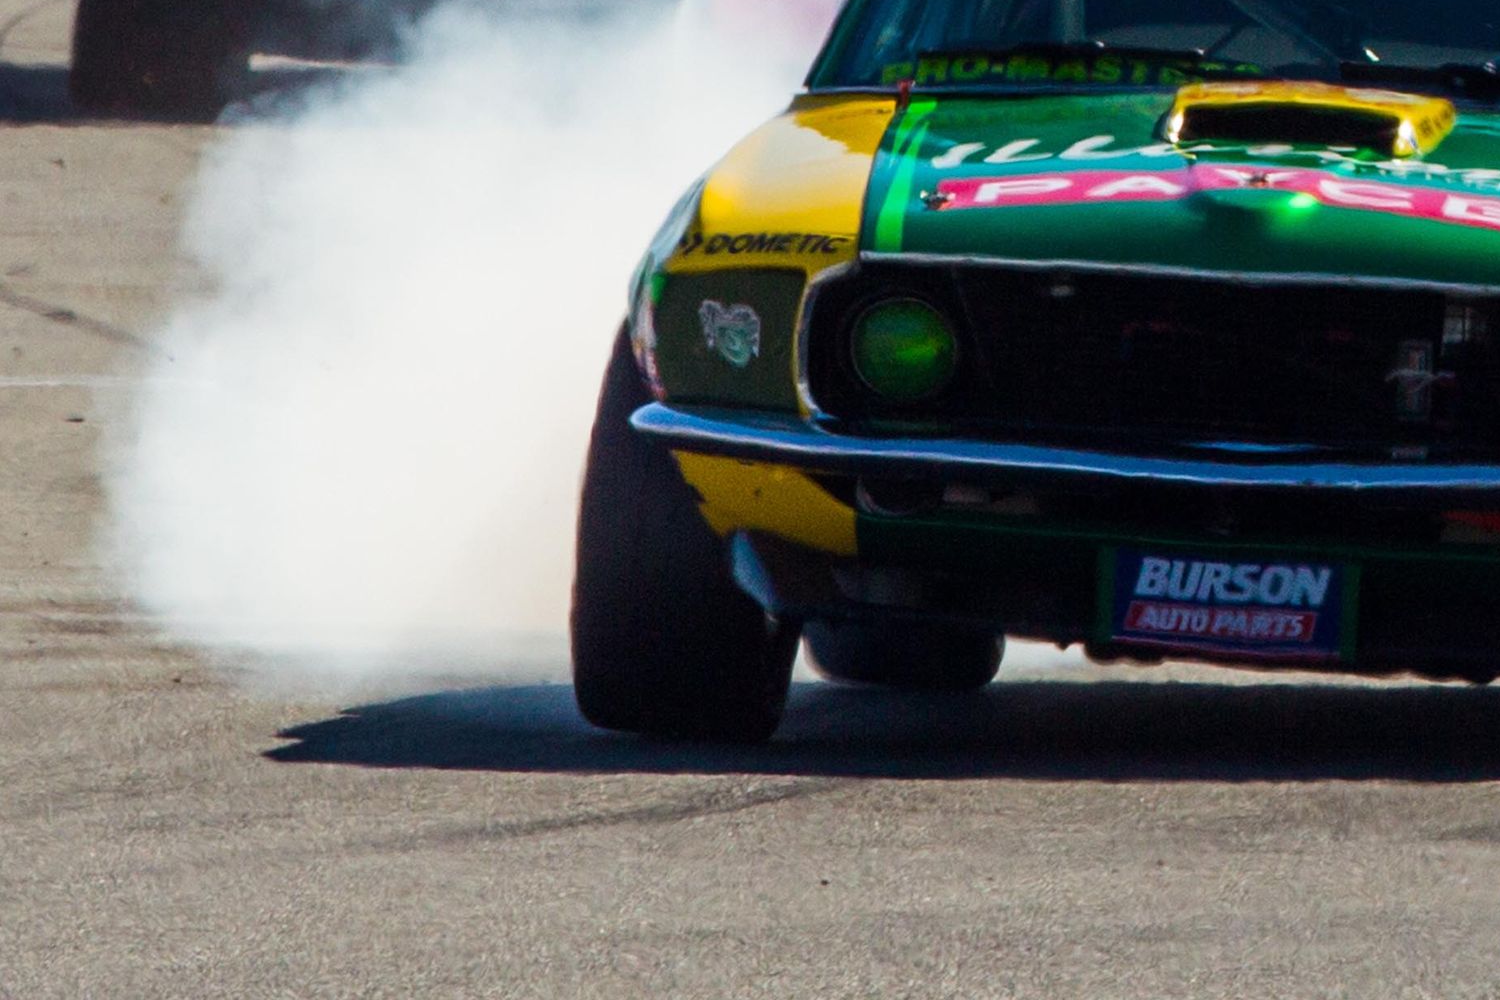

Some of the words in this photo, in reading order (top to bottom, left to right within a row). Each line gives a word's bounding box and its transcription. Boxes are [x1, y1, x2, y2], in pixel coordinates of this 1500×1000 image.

[706, 231, 850, 255] DOMETIC
[1134, 557, 1332, 608] BURSON
[1137, 607, 1210, 634] AUTO
[1211, 609, 1305, 638] PARTS
